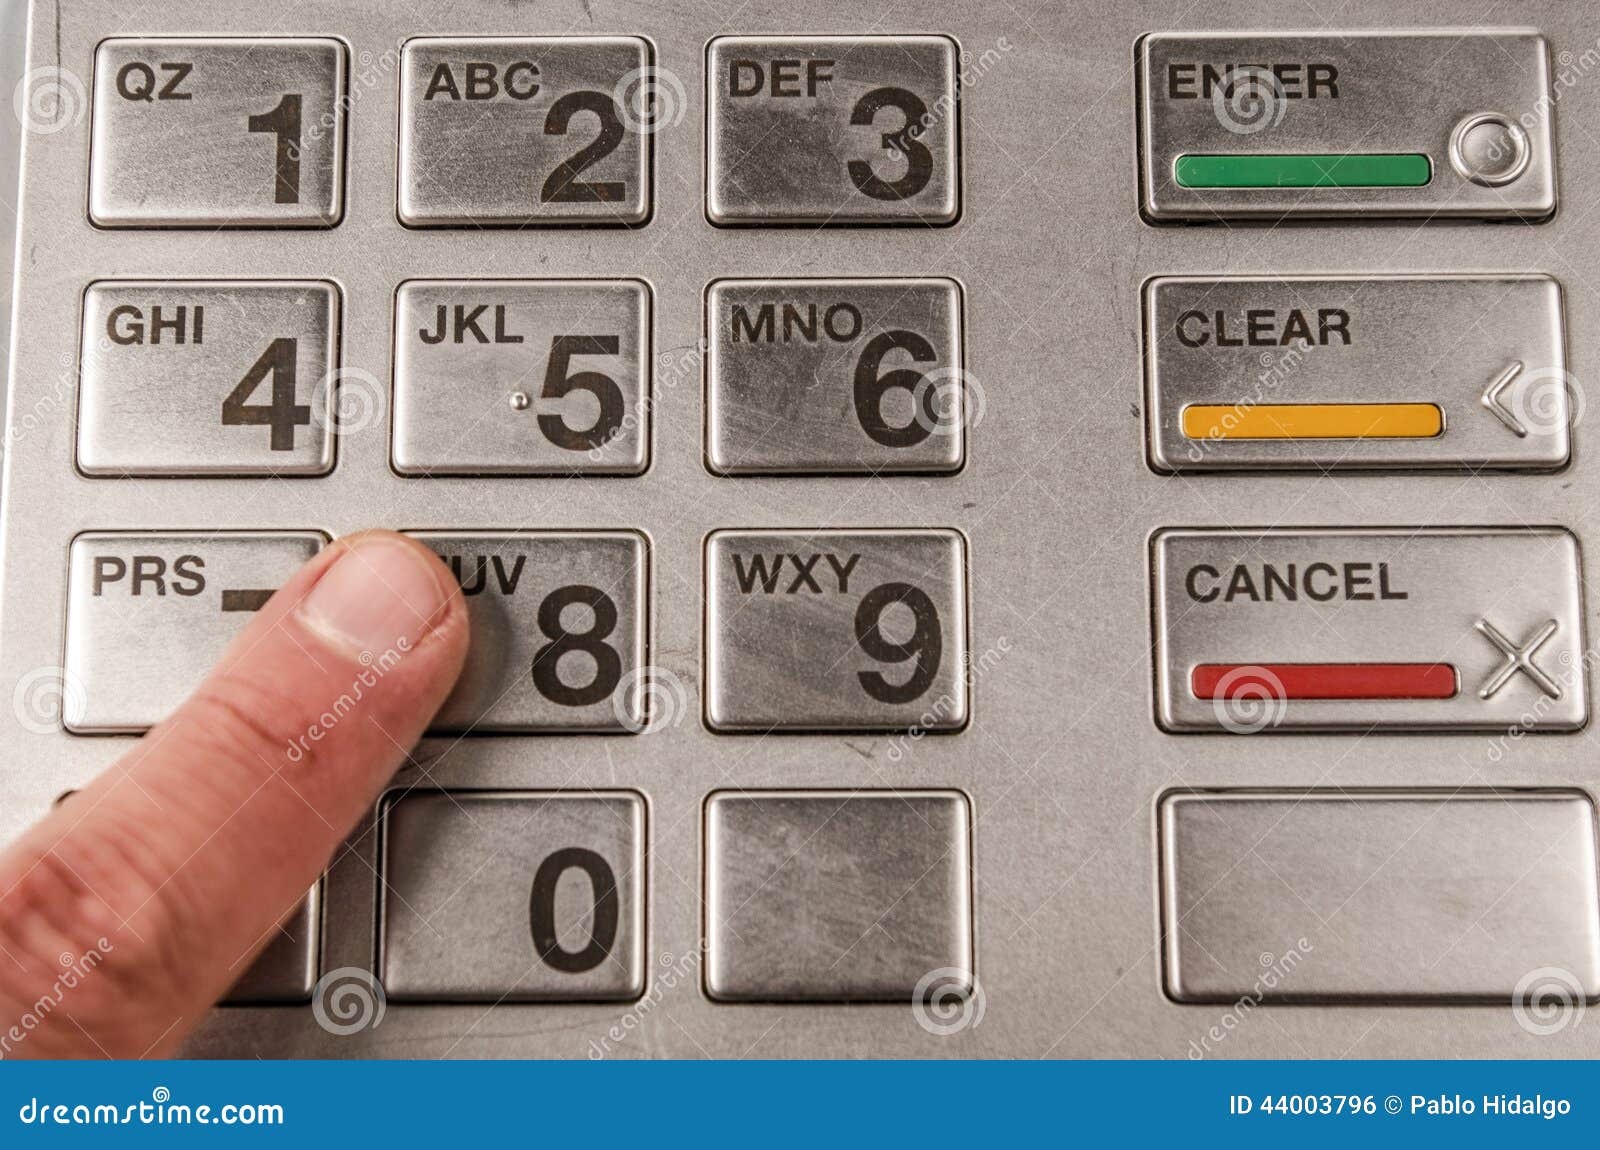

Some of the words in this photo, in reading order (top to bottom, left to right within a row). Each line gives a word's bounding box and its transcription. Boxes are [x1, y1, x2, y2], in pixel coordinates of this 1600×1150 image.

[116, 62, 193, 102] QZ
[424, 61, 540, 101] ABC
[729, 60, 835, 98] DEF
[1168, 64, 1340, 100] ENTER
[248, 94, 302, 204] 1
[540, 91, 626, 203] 2
[847, 87, 933, 201] 3
[106, 305, 203, 345] GHI
[420, 304, 524, 345] JKL
[731, 302, 862, 344] MNO
[1176, 308, 1352, 348] CLEAR
[221, 338, 310, 452] 4
[536, 335, 624, 451] 5
[852, 330, 938, 448] 6
[93, 555, 206, 597] PRS
[439, 555, 527, 597] UV
[732, 554, 861, 595] WXY
[1185, 562, 1409, 603] CANCEL
[531, 585, 621, 707] 8
[854, 582, 941, 704] 9
[529, 847, 618, 974] 0
